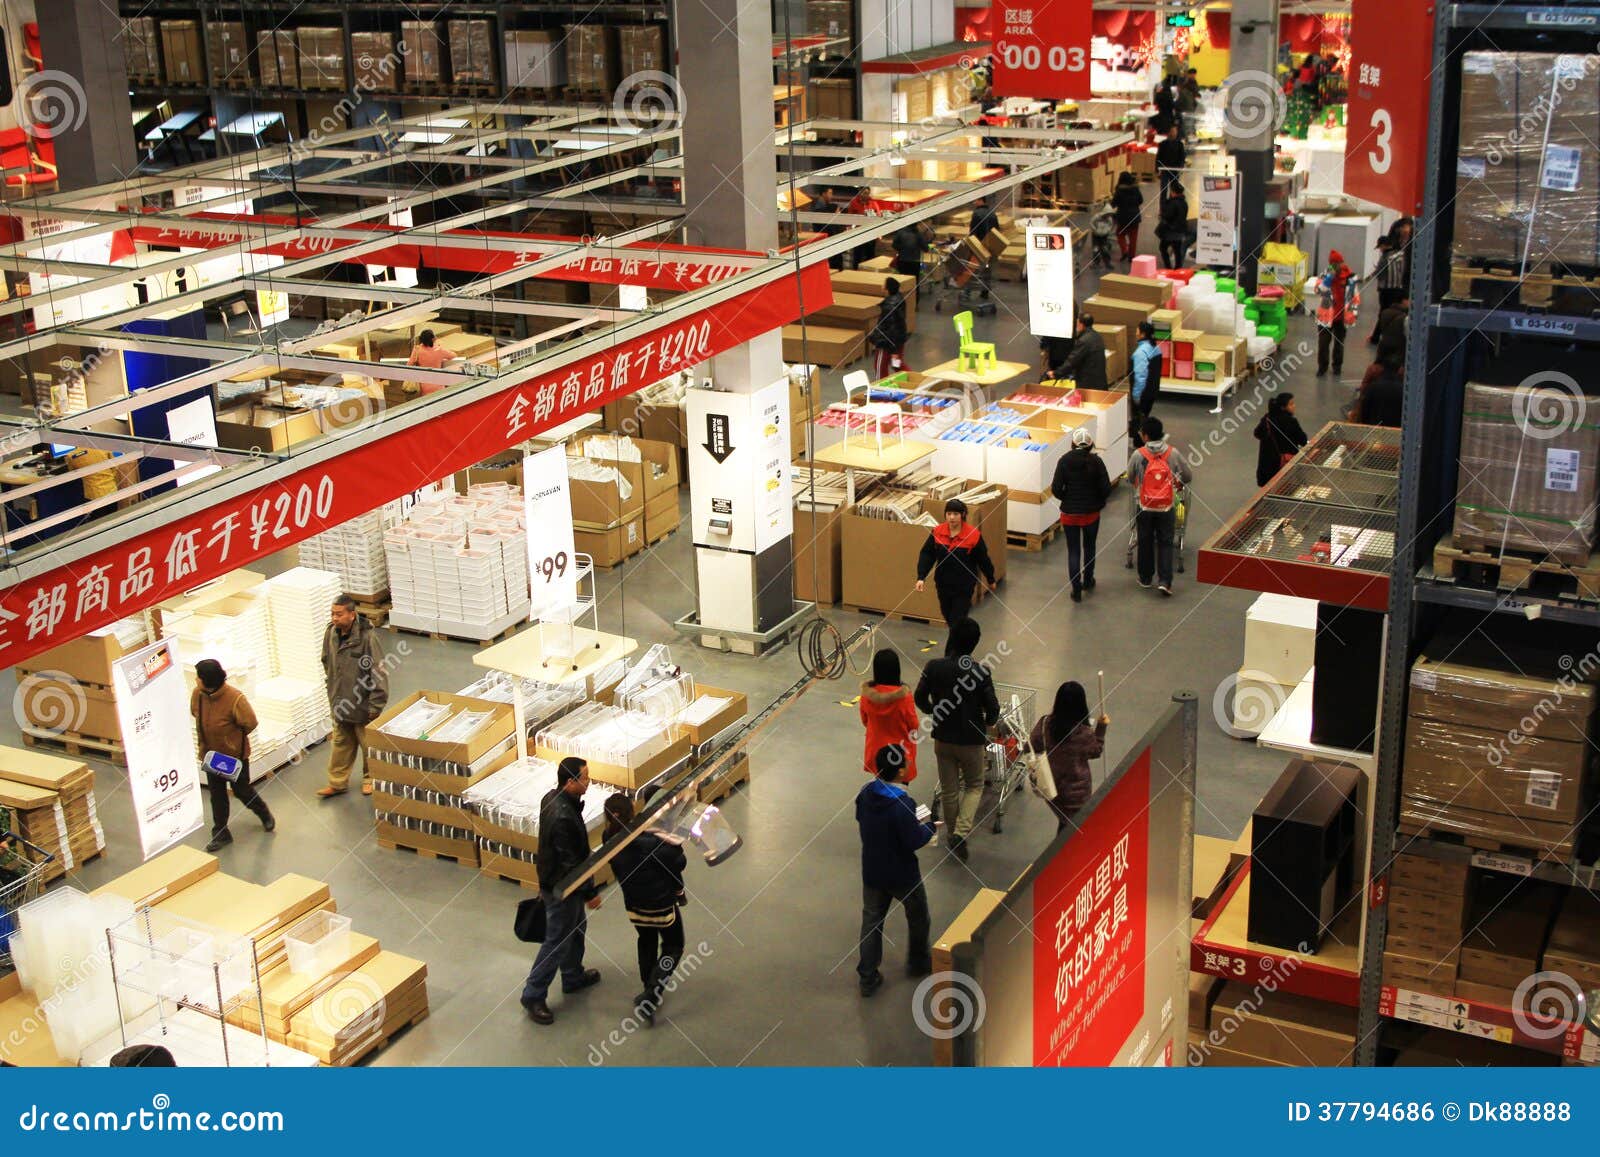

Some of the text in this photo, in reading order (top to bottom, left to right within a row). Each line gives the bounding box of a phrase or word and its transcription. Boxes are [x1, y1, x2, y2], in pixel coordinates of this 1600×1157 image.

[1004, 26, 1033, 35] AREA
[1005, 9, 1033, 24] 区域
[1004, 45, 1085, 72] 00 03
[1359, 63, 1381, 87] 货架
[1368, 108, 1392, 174] 3
[1528, 319, 1574, 331] 03-01-40
[505, 319, 711, 439] 全部商品低于¥200
[535, 551, 568, 584] ¥99
[153, 769, 179, 792] ¥99
[1054, 832, 1129, 960] 在哪里取
[1054, 883, 1128, 1013] 你的家具
[1204, 952, 1247, 975] 货架 3
[1050, 929, 1133, 1050] Where to pick up
[1056, 963, 1126, 1067] your furniture
